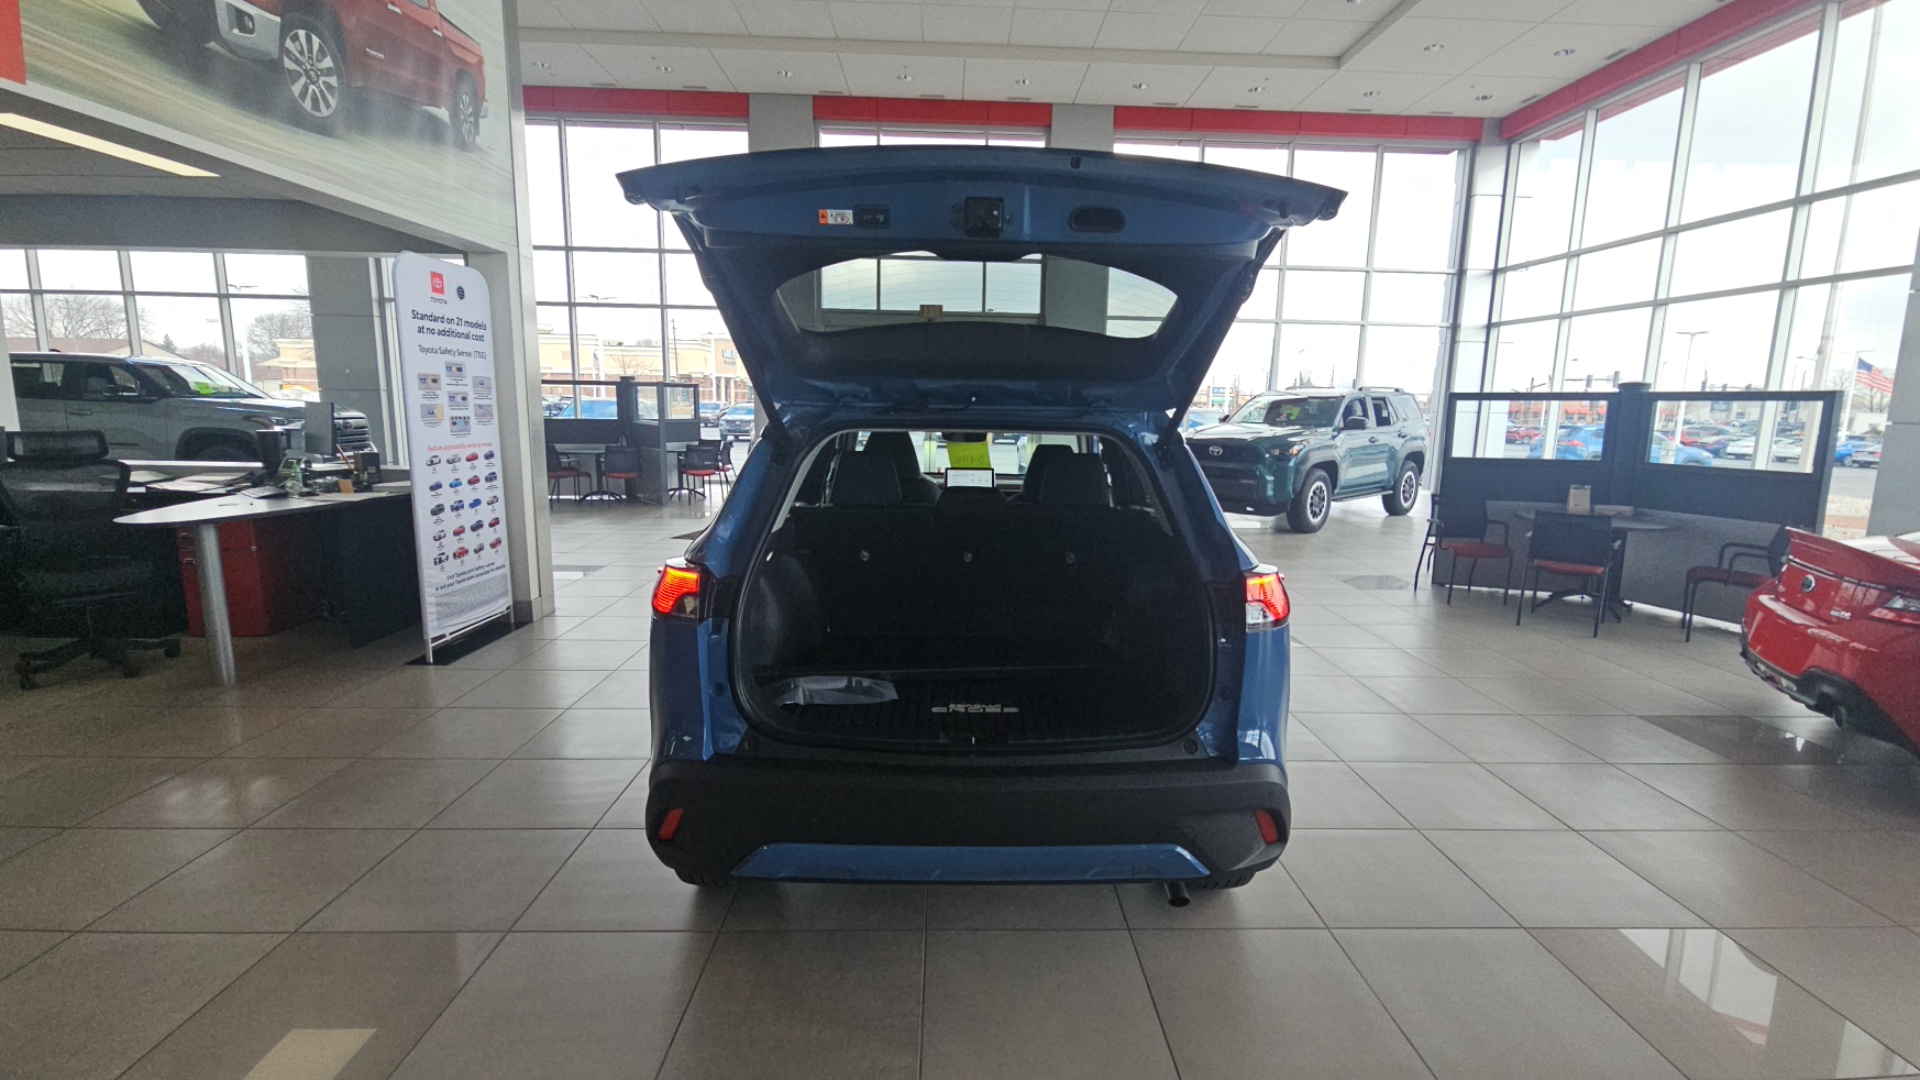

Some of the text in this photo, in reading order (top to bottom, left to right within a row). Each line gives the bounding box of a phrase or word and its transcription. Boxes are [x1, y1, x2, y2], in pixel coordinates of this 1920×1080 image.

[430, 297, 448, 305] TOYOTA
[411, 310, 487, 331] Standard on 21 models
[417, 325, 485, 342] at no additional cost
[418, 344, 438, 355] Toyota
[438, 346, 456, 357] Safety
[456, 348, 472, 358] Sense
